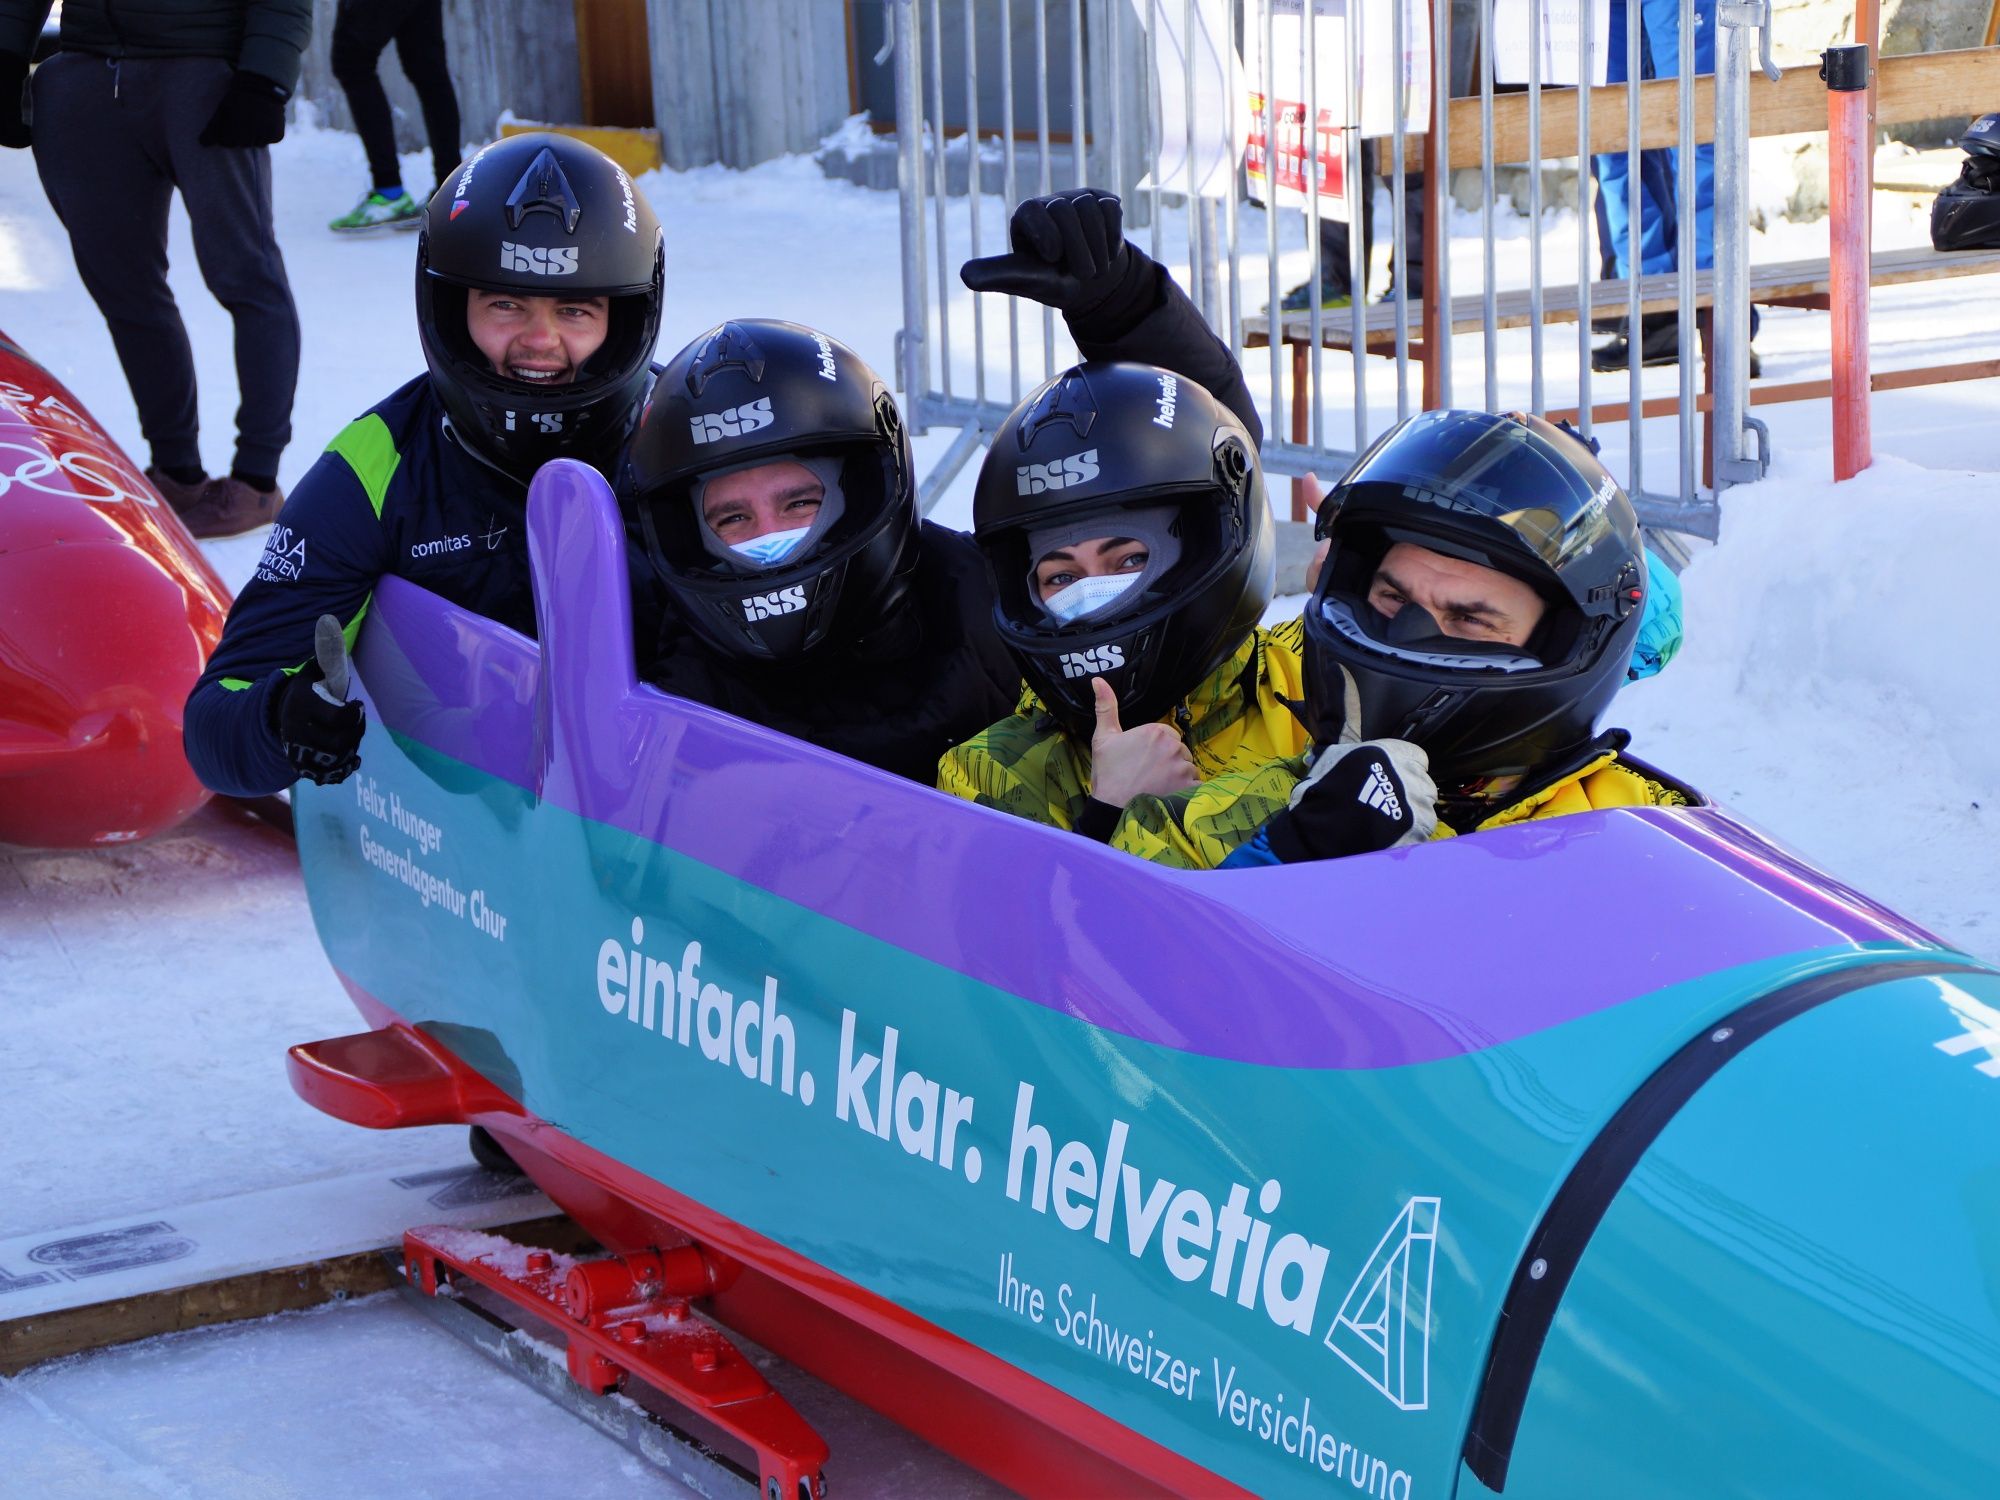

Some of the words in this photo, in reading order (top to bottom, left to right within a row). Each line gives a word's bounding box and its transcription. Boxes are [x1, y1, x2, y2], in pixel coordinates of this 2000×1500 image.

[411, 532, 472, 558] comitas
[355, 773, 389, 823] Felix
[389, 791, 442, 855] Hunger
[1370, 762, 1403, 821] adidas
[359, 824, 467, 919] Generalagentur
[469, 889, 507, 942] Chur
[597, 916, 815, 1106] einfach.
[835, 1007, 983, 1184] klar.
[1005, 1080, 1330, 1336] helvetia
[998, 1253, 1045, 1323] Ihre
[1055, 1283, 1200, 1401] Schweizer
